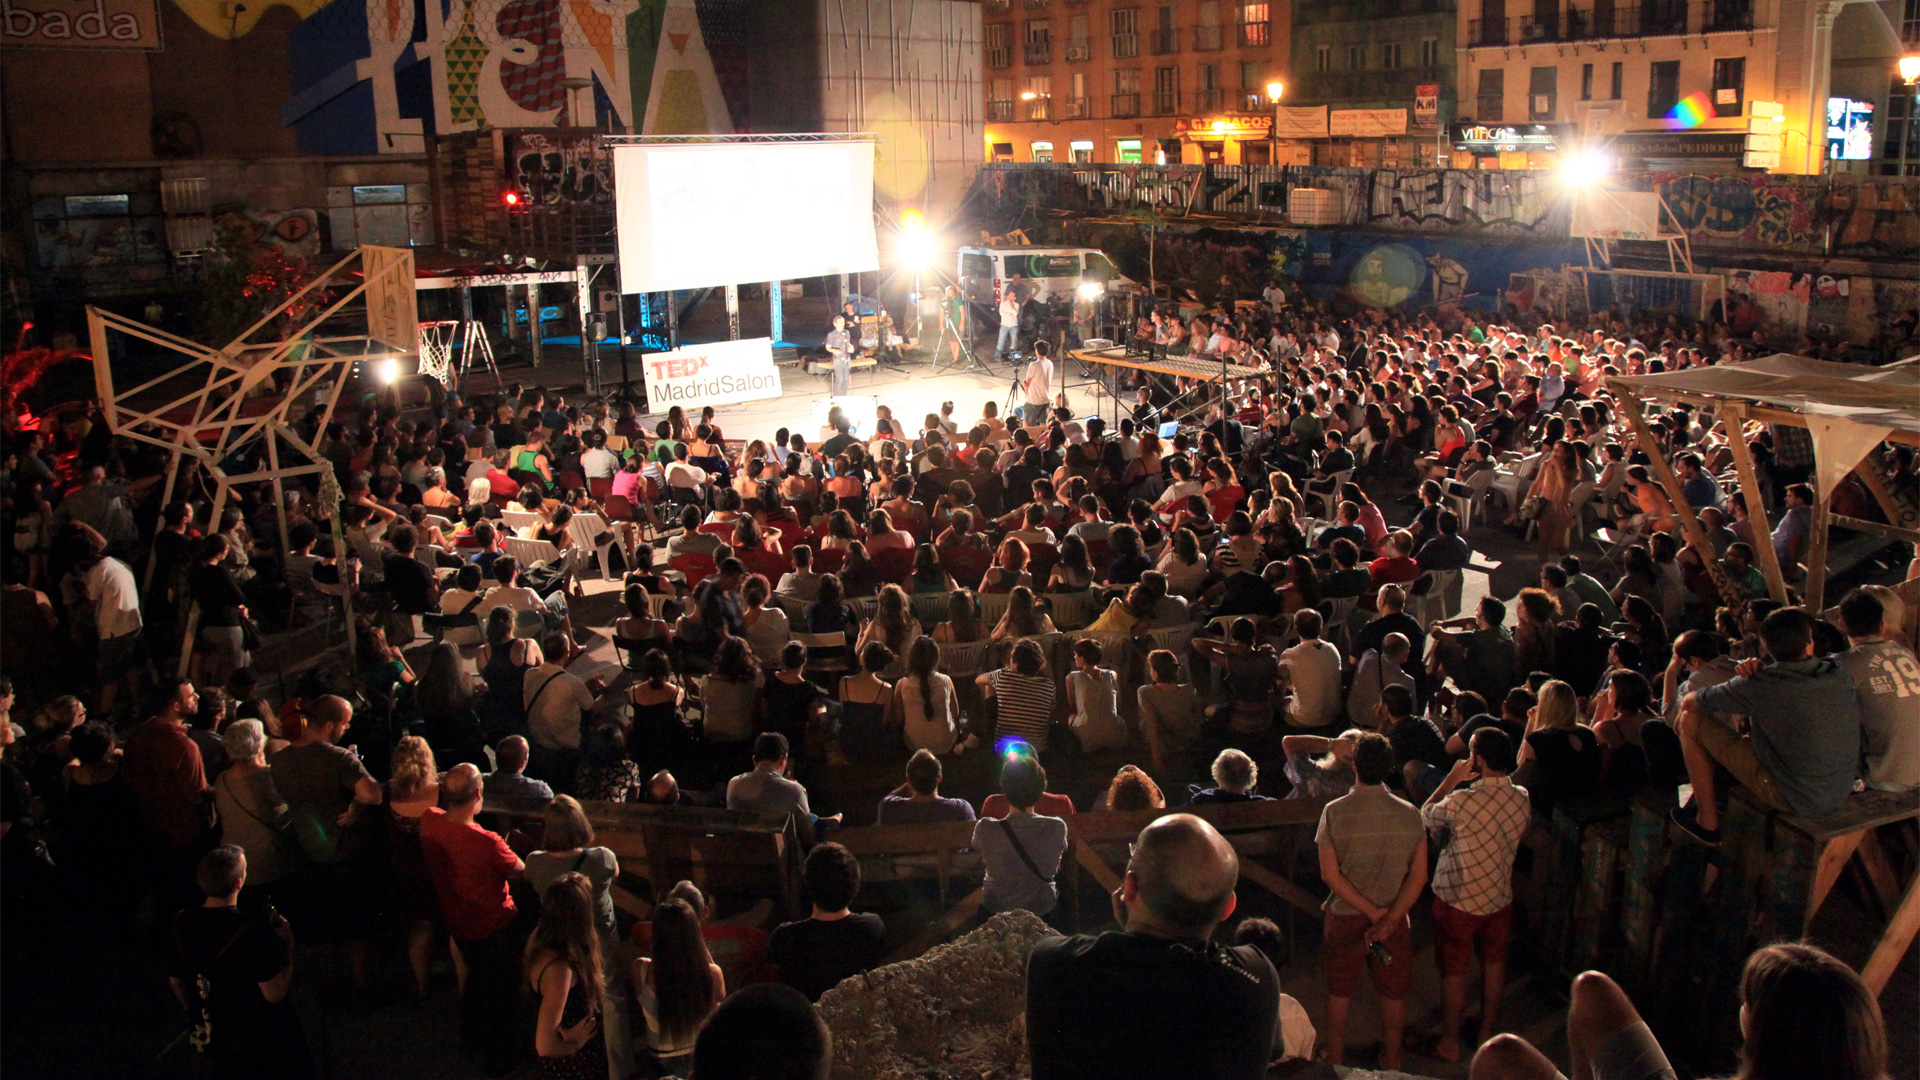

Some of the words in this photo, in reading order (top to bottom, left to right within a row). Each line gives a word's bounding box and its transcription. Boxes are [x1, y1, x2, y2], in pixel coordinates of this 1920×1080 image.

[5, 0, 141, 40] bada
[1202, 116, 1273, 130] TABACOS
[651, 355, 710, 381] TEDx
[653, 373, 776, 403] MadridSalon
